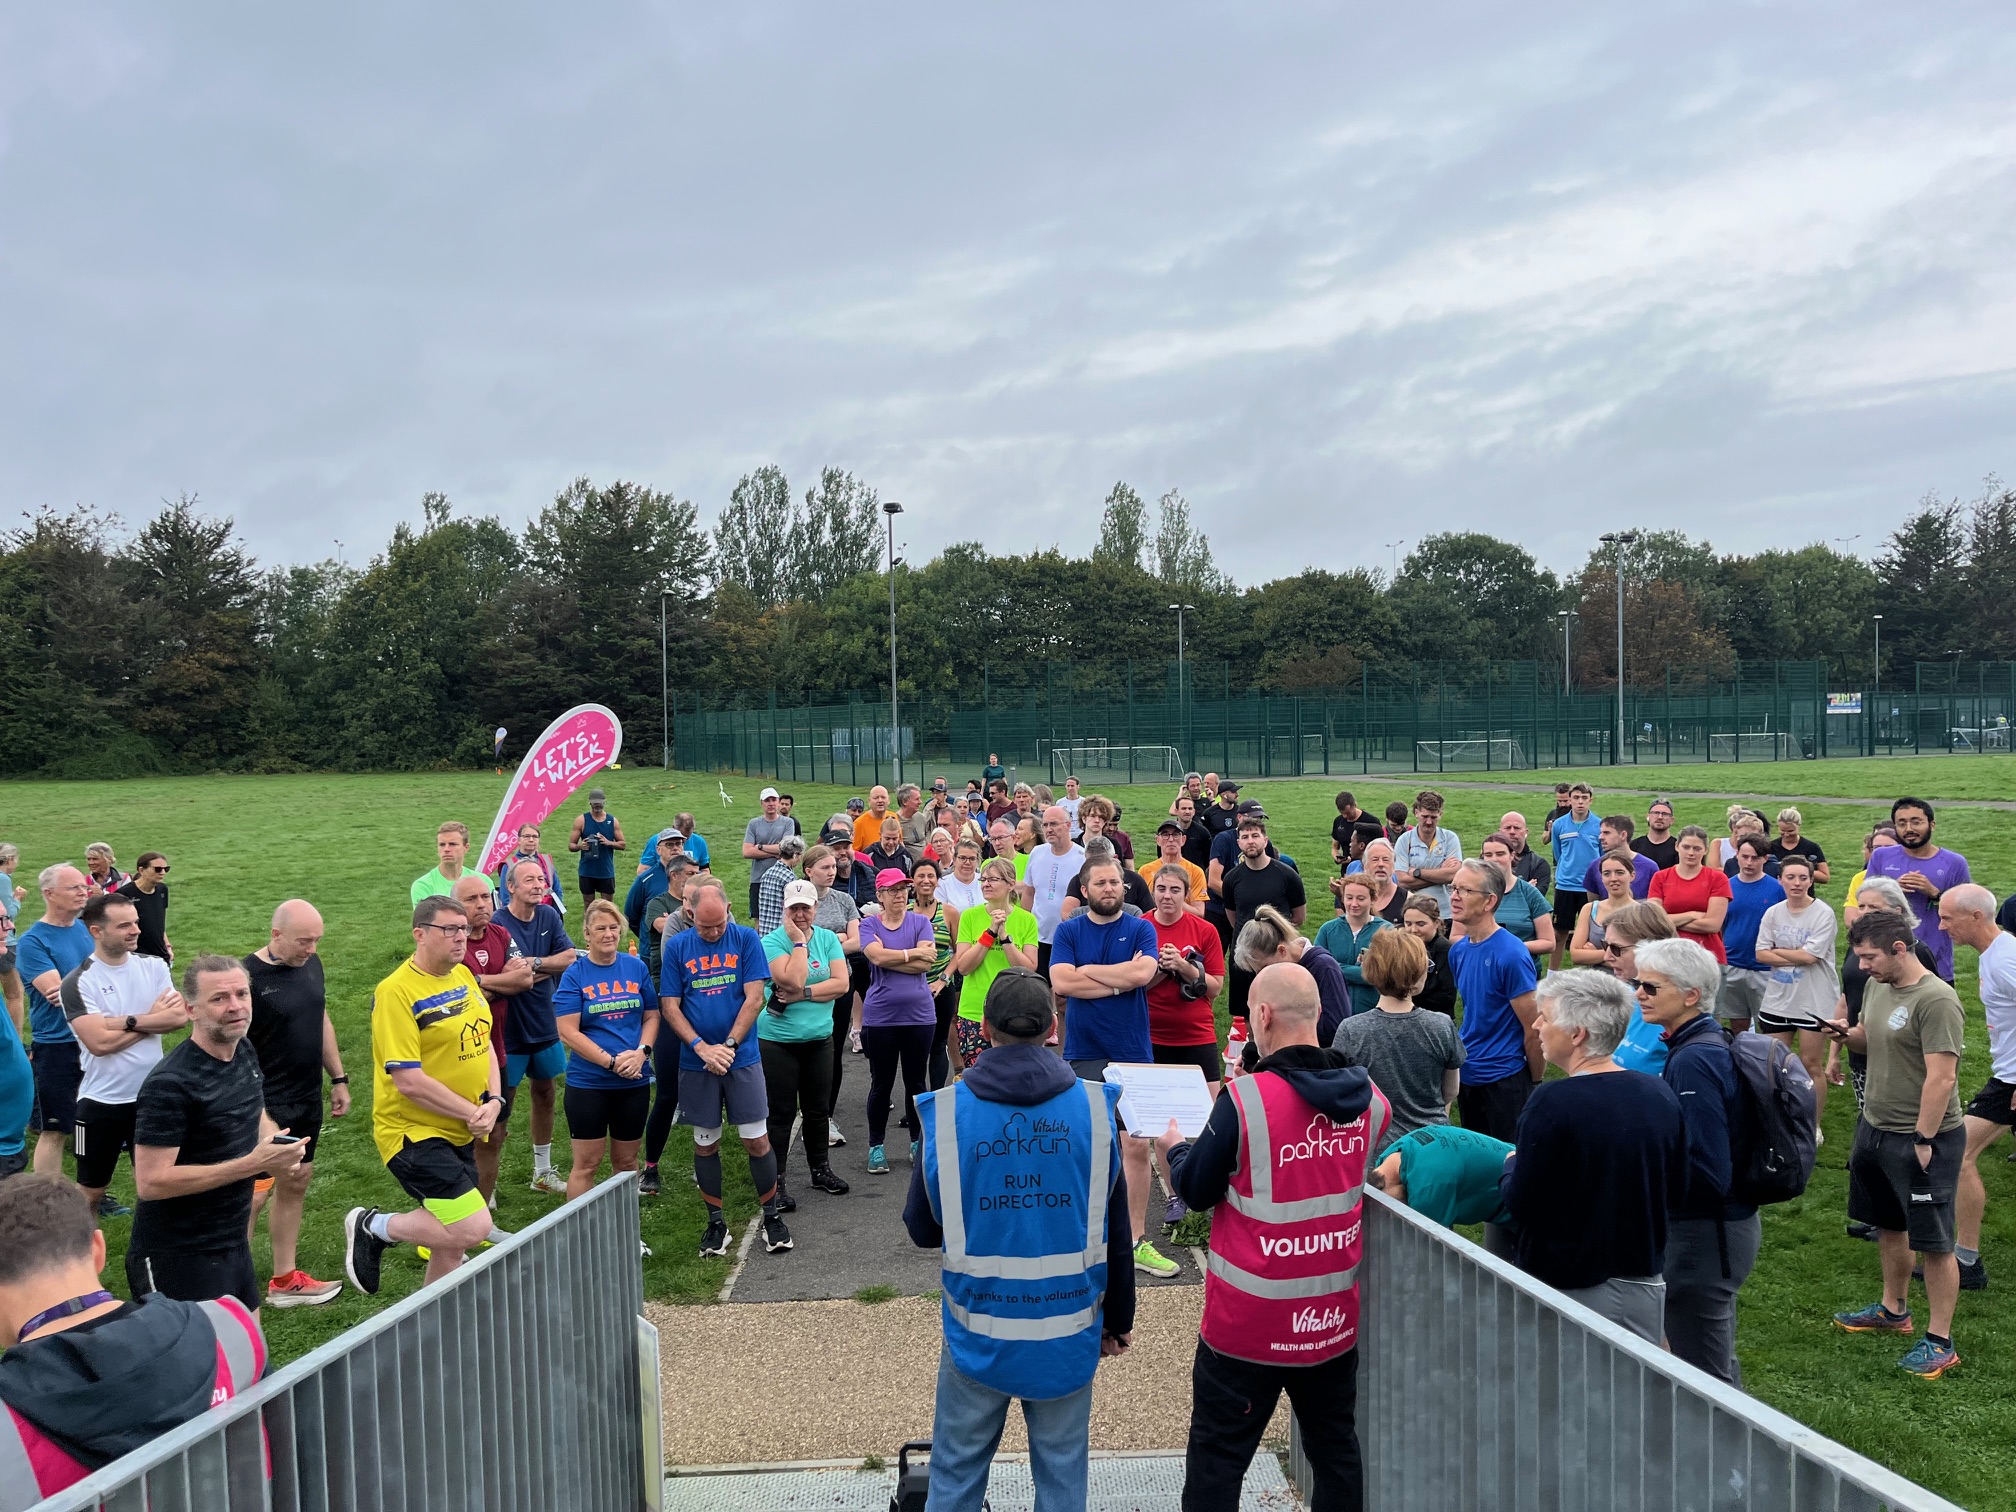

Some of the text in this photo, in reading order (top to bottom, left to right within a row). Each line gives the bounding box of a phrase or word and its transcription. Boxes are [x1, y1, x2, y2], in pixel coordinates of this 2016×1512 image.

[533, 731, 589, 778] LET'S
[548, 741, 605, 784] WALK
[685, 953, 739, 975] TEAM
[582, 980, 640, 1000] TEAM
[458, 1053, 476, 1062] TOTAL
[1032, 1116, 1070, 1138] Vitality
[976, 1126, 1071, 1162] parkrun
[1279, 1128, 1364, 1167] parkrun
[1004, 1173, 1042, 1189] RUN
[979, 1193, 1072, 1211] DIRECTOR
[966, 1288, 1003, 1303] Thanks
[1006, 1294, 1019, 1304] to
[1022, 1294, 1042, 1304] the
[1292, 1306, 1346, 1333] Vitality
[1270, 1342, 1298, 1351] HEALTH
[1299, 1342, 1314, 1351] AND
[1315, 1340, 1327, 1350] LIFE
